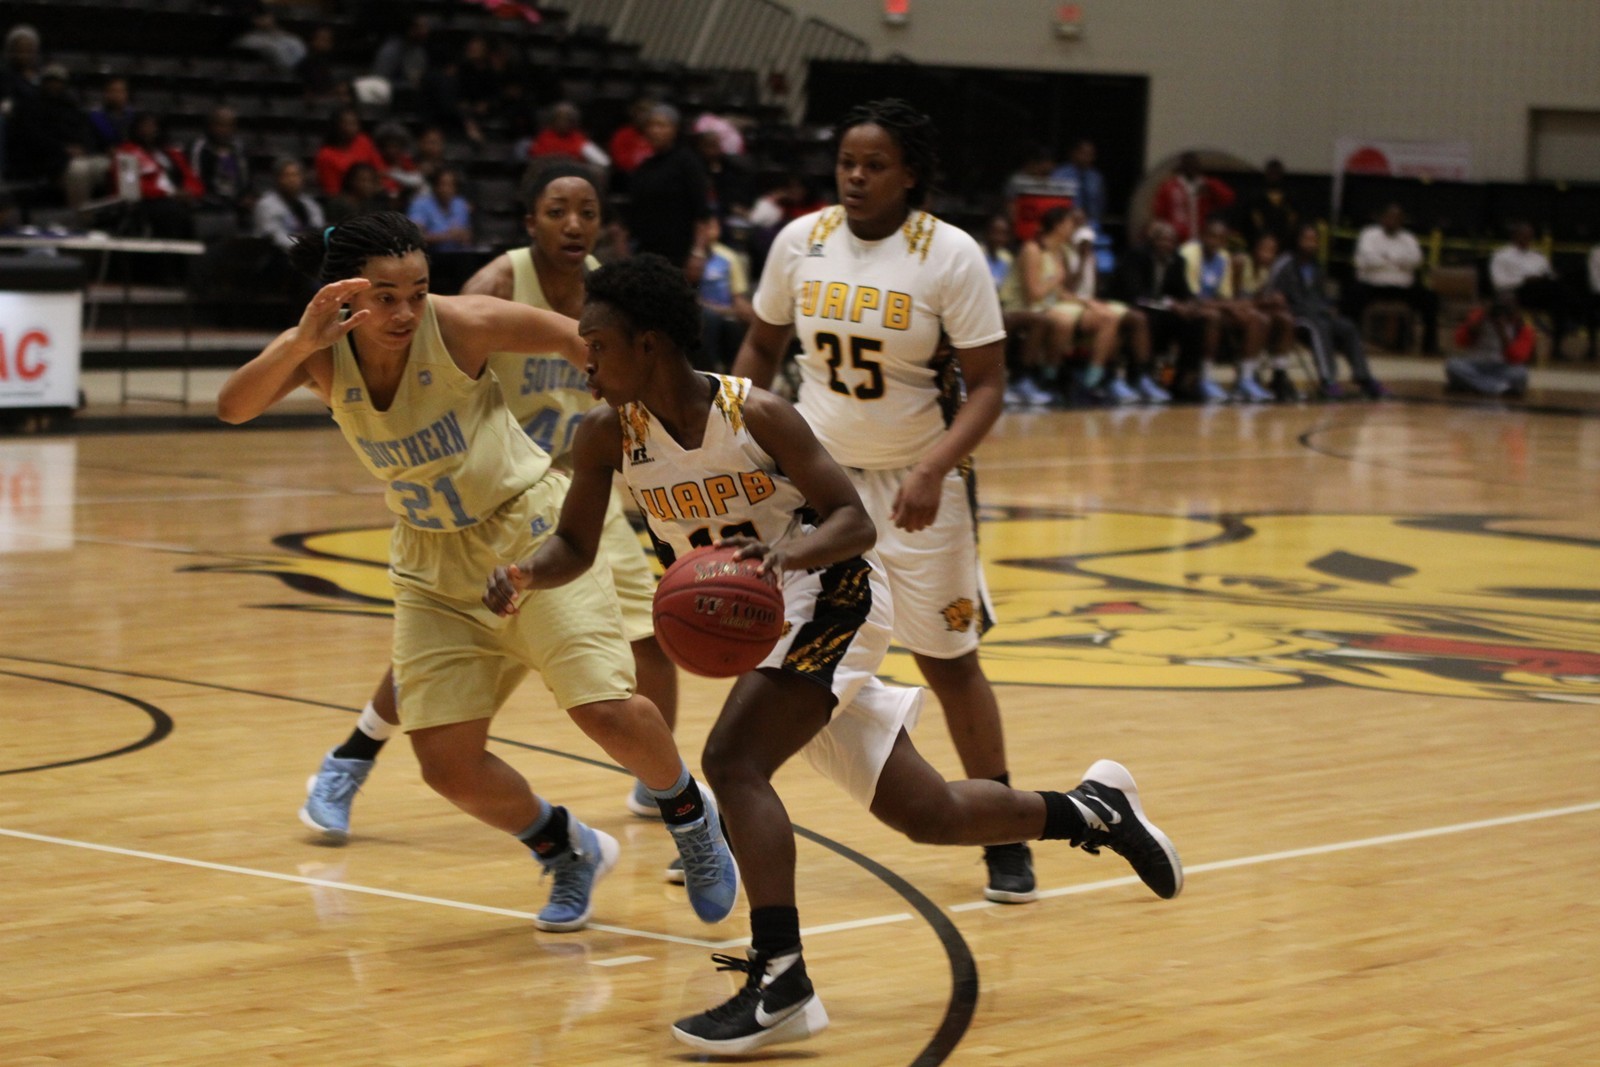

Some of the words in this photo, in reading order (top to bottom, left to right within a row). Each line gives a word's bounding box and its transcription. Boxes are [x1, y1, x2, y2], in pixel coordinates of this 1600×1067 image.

[802, 280, 912, 331] UAPB
[815, 331, 885, 400] 25
[391, 477, 478, 530] 21
[641, 468, 777, 522] UAPB
